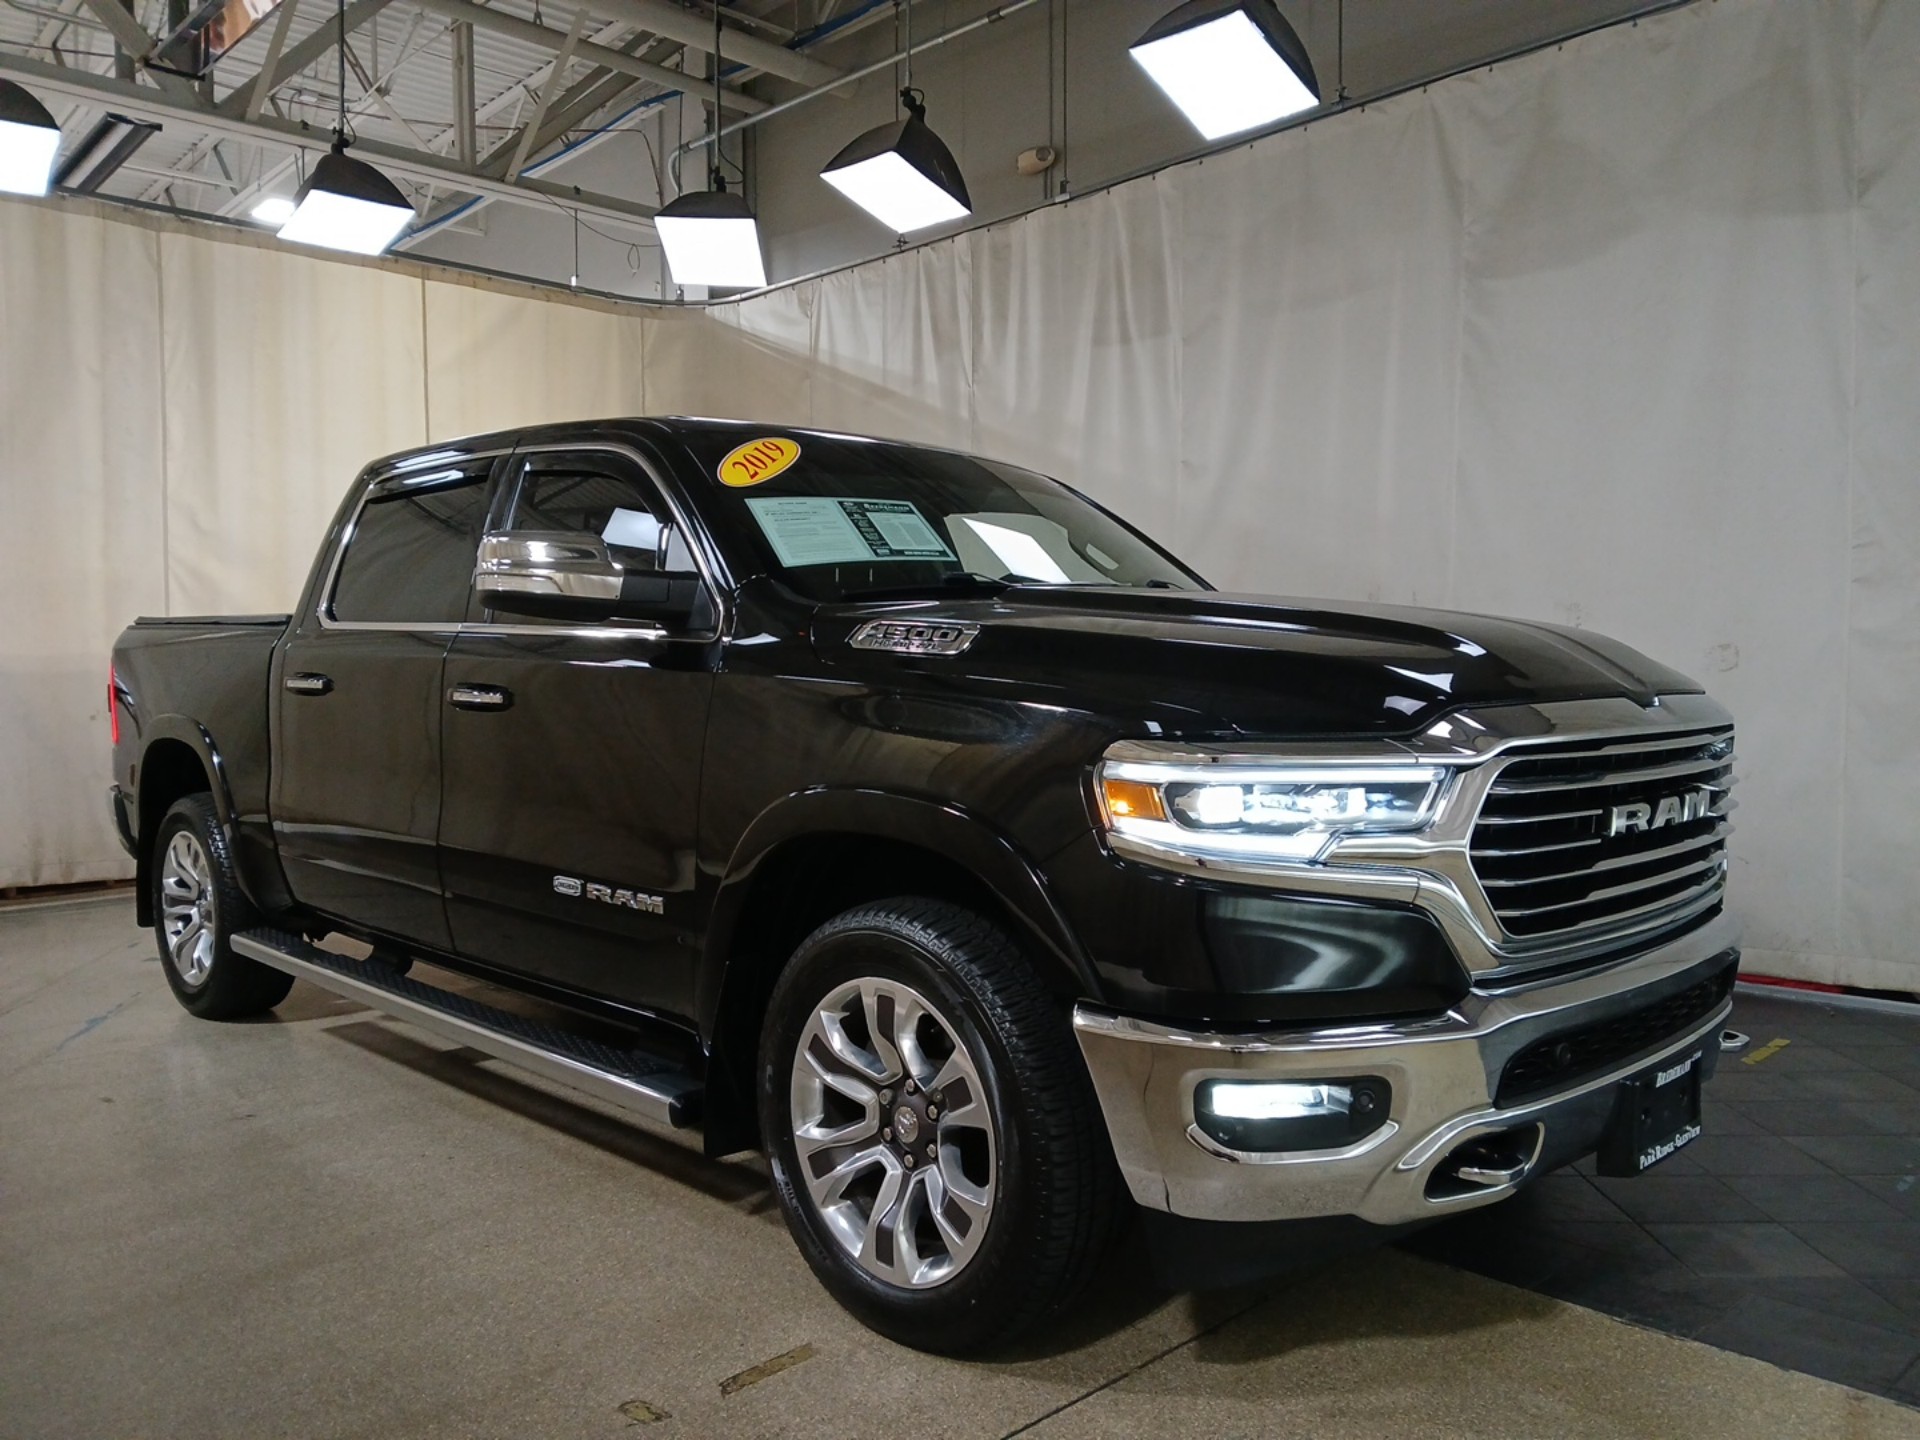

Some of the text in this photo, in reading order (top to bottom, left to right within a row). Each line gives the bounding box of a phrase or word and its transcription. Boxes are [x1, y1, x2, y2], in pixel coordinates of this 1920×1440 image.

[732, 440, 785, 480] 2019
[864, 624, 959, 642] 1500
[1610, 789, 1711, 838] RAM
[586, 882, 664, 915] RAM
